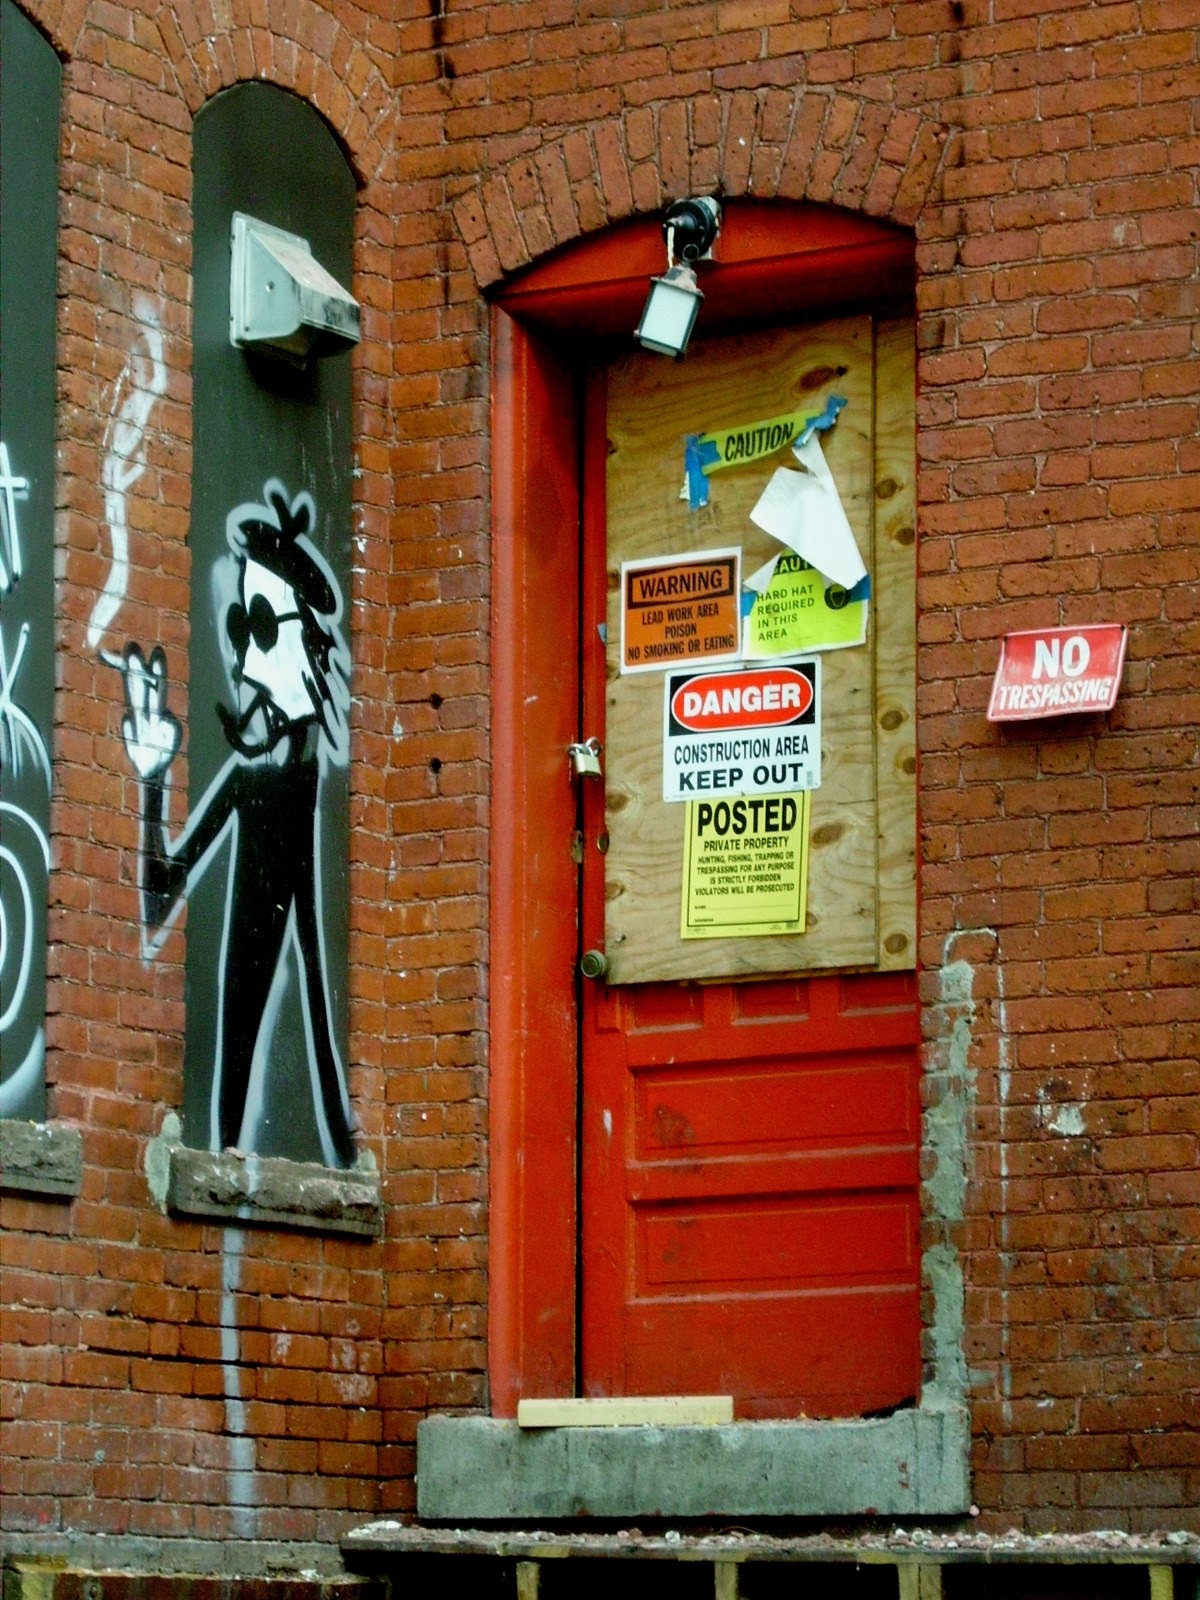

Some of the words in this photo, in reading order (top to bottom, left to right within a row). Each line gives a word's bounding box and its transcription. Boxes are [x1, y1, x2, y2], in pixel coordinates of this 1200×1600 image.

[724, 421, 795, 462] CAUTION
[639, 569, 723, 599] WARNING
[757, 588, 788, 602] HARD
[791, 584, 815, 597] HAT
[641, 610, 664, 626] LEAD
[667, 606, 694, 622] WORK
[697, 602, 720, 617] AREA
[757, 597, 816, 615] REQUIRED
[664, 623, 697, 639] POISON
[758, 618, 770, 629] IN
[773, 613, 798, 625] THIS
[758, 628, 788, 641] AREA
[628, 647, 641, 661] NO
[643, 640, 685, 659] SMOKING
[688, 639, 701, 653] OR
[704, 634, 735, 651] EATING
[1031, 635, 1091, 680] NO
[683, 682, 801, 718] DANGER
[999, 678, 1112, 710] TRESPASSING
[674, 738, 771, 766] CONSTRUCTION
[775, 734, 809, 756] AREA
[679, 767, 744, 792] KEEP
[752, 762, 803, 786] OUT
[697, 797, 797, 837] POSTED
[704, 838, 741, 852] PRIVATE
[743, 836, 790, 850] PROPERTY
[754, 851, 784, 861] TRAPPING
[785, 850, 795, 860] OR
[697, 864, 739, 875] TRESPASSING
[740, 864, 752, 873] FOR
[753, 863, 766, 872] ANY
[767, 861, 795, 871] PURPOSE
[695, 887, 729, 896] VIOLATORS
[731, 886, 744, 895] WILL
[746, 885, 755, 894] BE
[756, 882, 795, 893] PROSECUTED
[710, 876, 716, 885] IS
[717, 875, 746, 885] STRICTLY
[747, 873, 782, 883] FORBIDDEN
